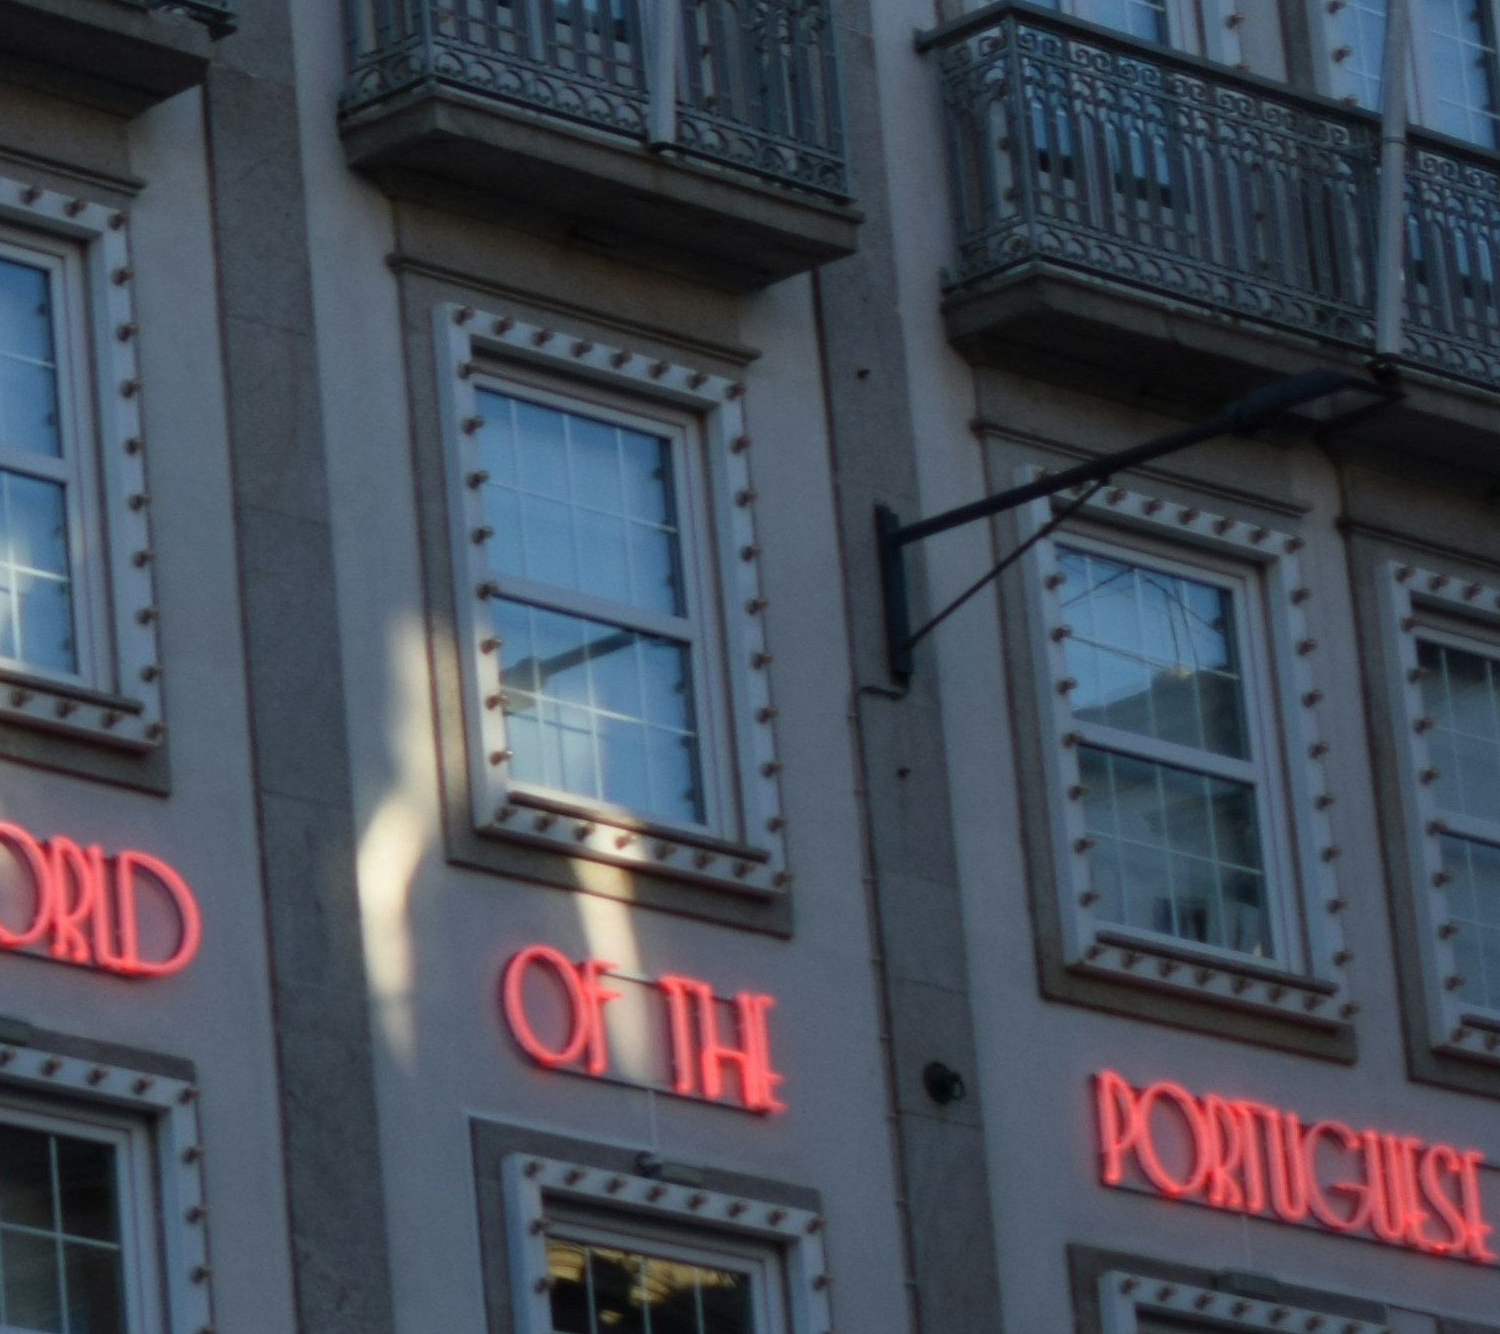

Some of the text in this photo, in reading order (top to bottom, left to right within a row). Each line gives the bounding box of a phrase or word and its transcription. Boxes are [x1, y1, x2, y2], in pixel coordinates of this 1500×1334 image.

[500, 942, 623, 1076] OF
[656, 972, 790, 1116] THE
[1092, 1069, 1498, 1266] PORTUGUESE
